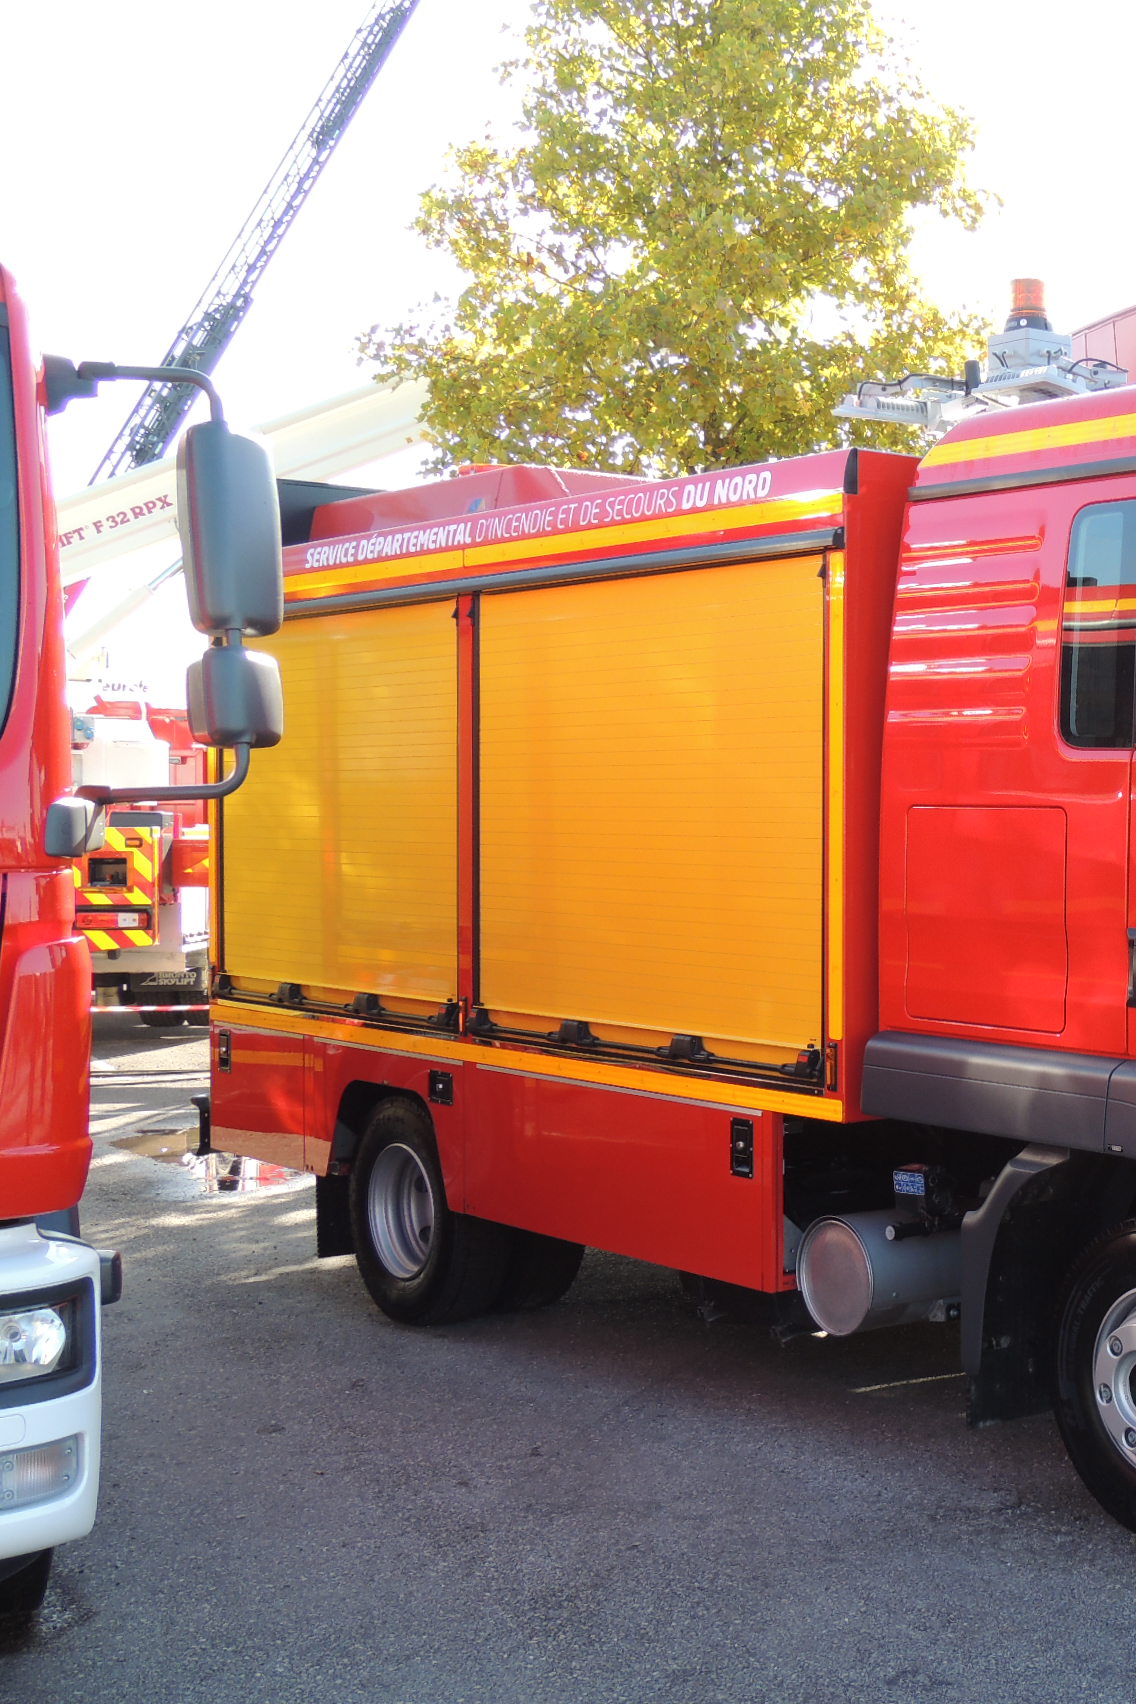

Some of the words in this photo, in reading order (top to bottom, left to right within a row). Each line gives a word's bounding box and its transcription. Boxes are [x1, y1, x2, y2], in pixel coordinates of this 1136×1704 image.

[92, 519, 105, 534] F
[106, 511, 131, 530] 32
[130, 494, 174, 519] RPX
[305, 540, 357, 568] SERVICE
[358, 522, 472, 561] DÉPARTEMENTAL
[475, 507, 555, 542] D'INCENDIE
[557, 503, 578, 528] ET
[580, 500, 600, 525] DE
[605, 486, 679, 522] SECOURS
[681, 482, 712, 510] DU
[713, 470, 772, 497] NORD
